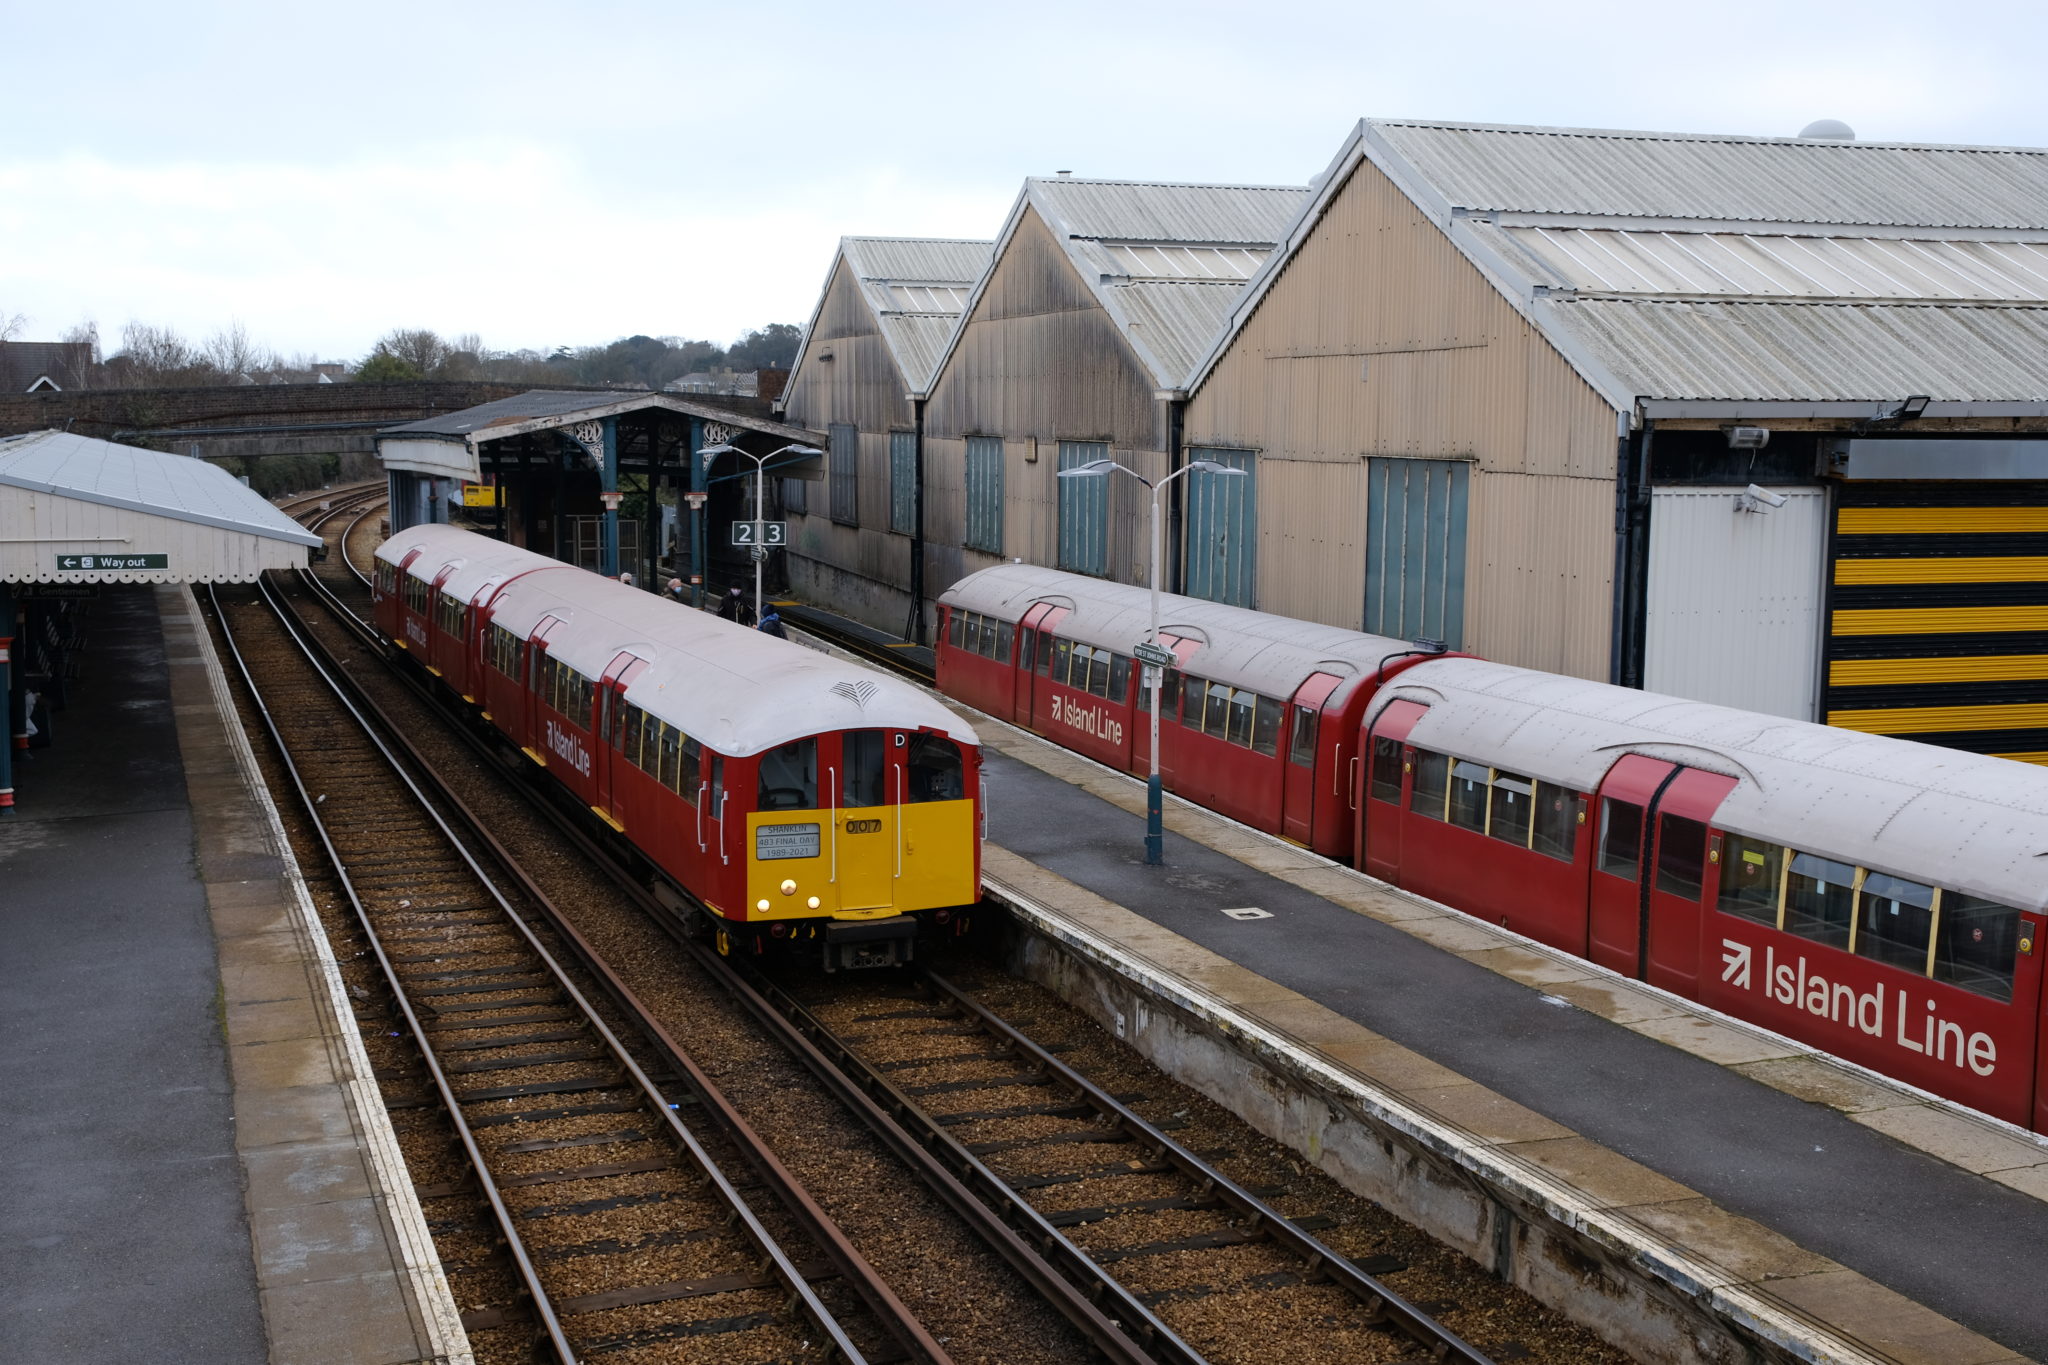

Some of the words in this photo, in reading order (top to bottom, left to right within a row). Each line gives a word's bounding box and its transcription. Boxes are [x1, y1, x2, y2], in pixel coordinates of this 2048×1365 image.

[739, 525, 751, 542] 2
[768, 524, 780, 542] 3
[100, 557, 124, 568] Way
[127, 558, 146, 567] out
[39, 586, 90, 596] Gentlemen
[1064, 695, 1096, 735] Island
[1097, 707, 1122, 746] Line
[895, 734, 905, 747] D
[553, 720, 574, 766] Island
[573, 735, 590, 778] Line
[768, 824, 807, 834] SHANKLIN
[846, 820, 881, 833] 007
[759, 838, 774, 846] 483
[775, 837, 798, 845] FINAL
[800, 836, 815, 844] DAY
[767, 848, 809, 857] 1989-2021
[1765, 946, 1885, 1038] Island
[1897, 989, 1997, 1077] Line
